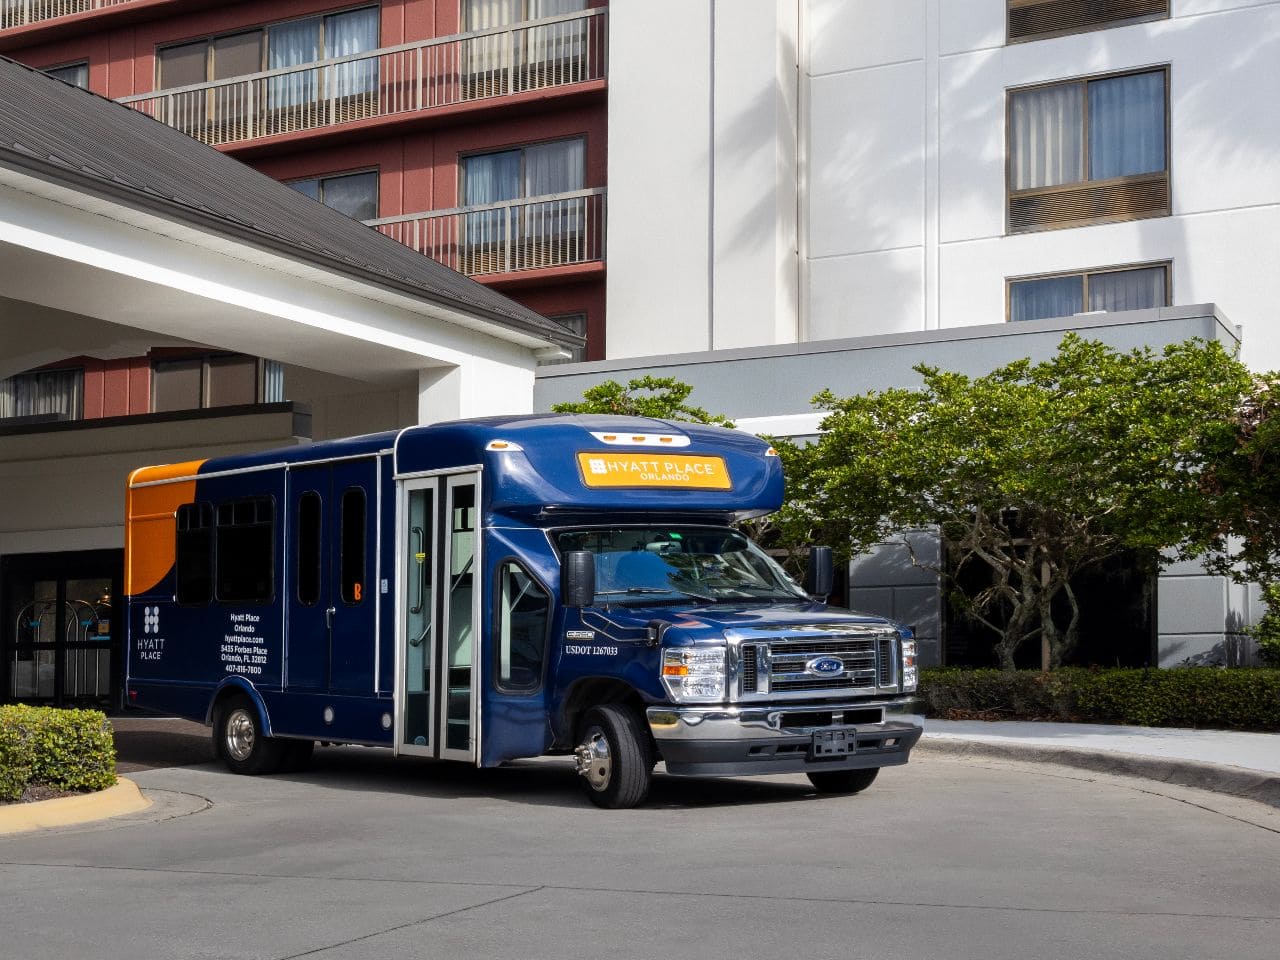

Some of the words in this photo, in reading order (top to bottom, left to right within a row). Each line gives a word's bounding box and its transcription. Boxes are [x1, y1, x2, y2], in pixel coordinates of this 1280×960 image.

[607, 461, 660, 473] HYATT
[665, 463, 714, 475] PLACE
[640, 472, 690, 481] ORLANDO
[230, 613, 244, 623] Hyatt
[245, 613, 260, 622] Place
[234, 623, 255, 633] Orlando
[137, 638, 165, 650] HYATT
[224, 634, 264, 644] hyattplace.com
[220, 644, 234, 653] 5435
[234, 645, 252, 654] Forbes
[252, 646, 268, 655] Place
[565, 645, 591, 655] USDOT
[592, 646, 618, 656] 1267033
[140, 651, 161, 660] PLACE
[243, 654, 251, 663] FL
